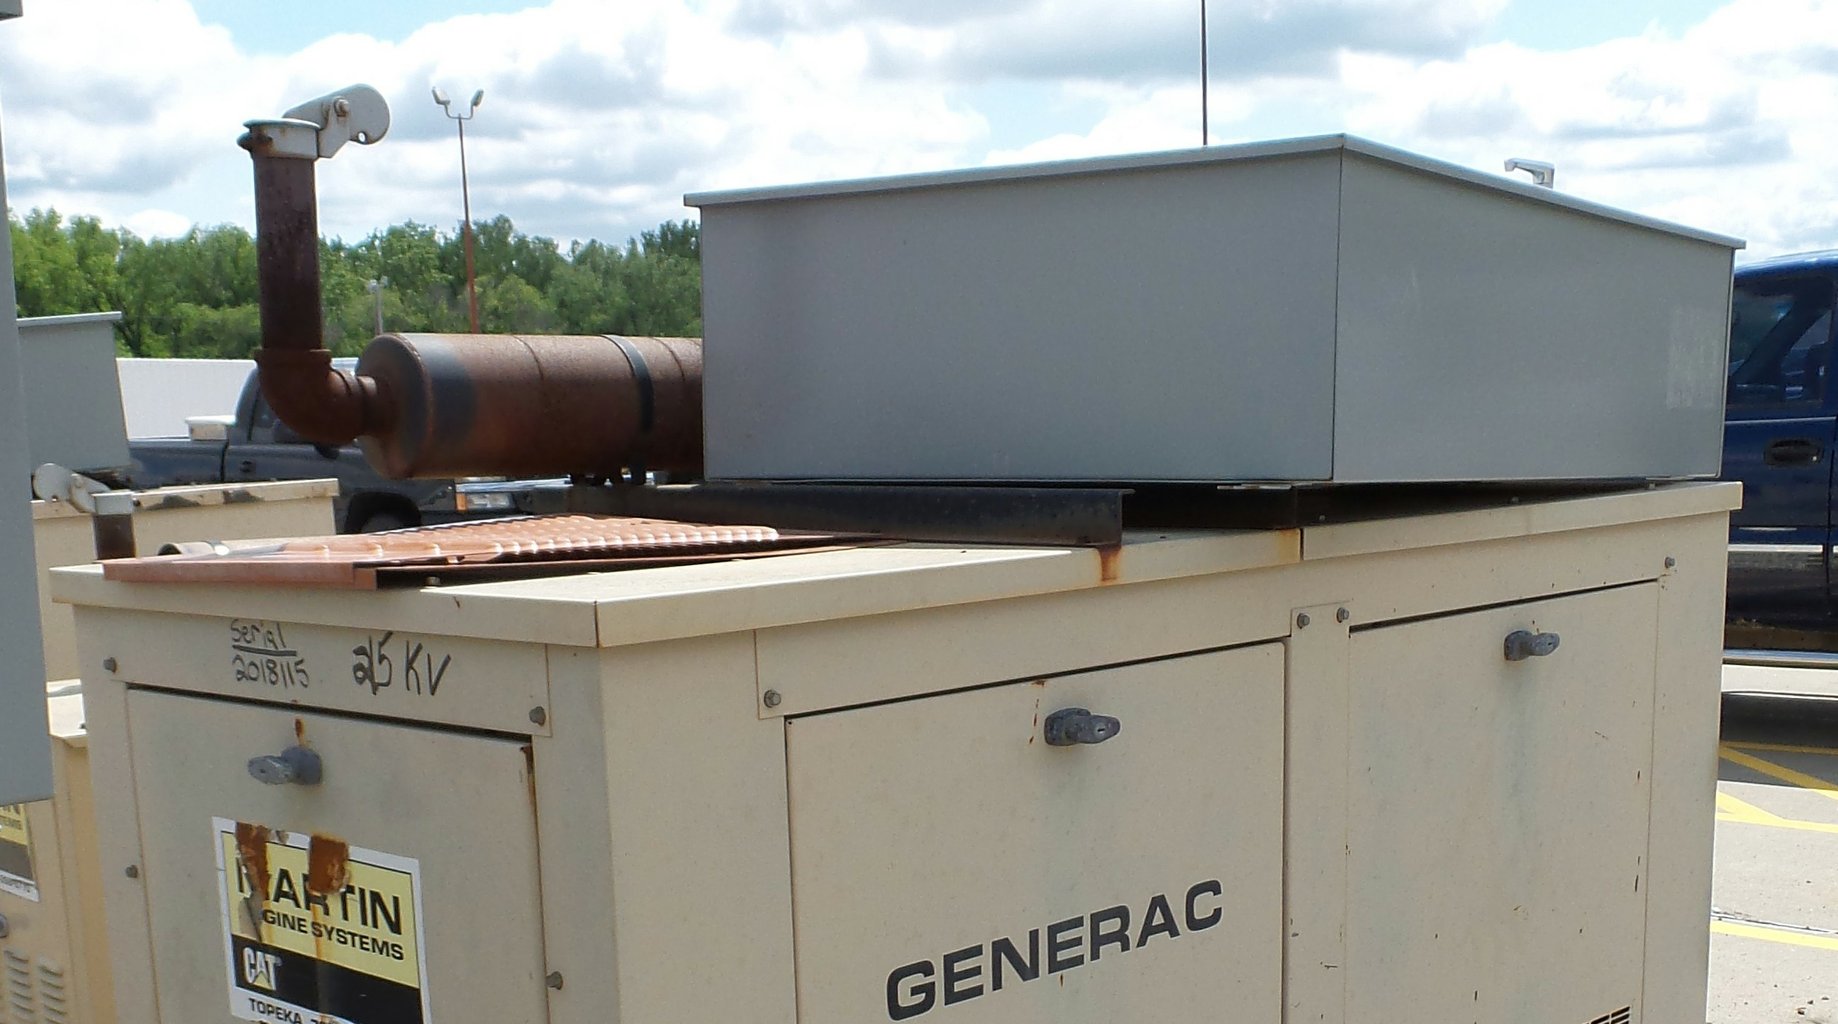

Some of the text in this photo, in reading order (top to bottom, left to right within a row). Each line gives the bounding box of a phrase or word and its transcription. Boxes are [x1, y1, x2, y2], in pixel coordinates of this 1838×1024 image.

[232, 655, 310, 689] 2018115
[406, 640, 452, 696] KV
[261, 909, 404, 961] GINE SYSTEMS
[886, 880, 1223, 1022] GENERAC
[242, 947, 277, 991] CAT
